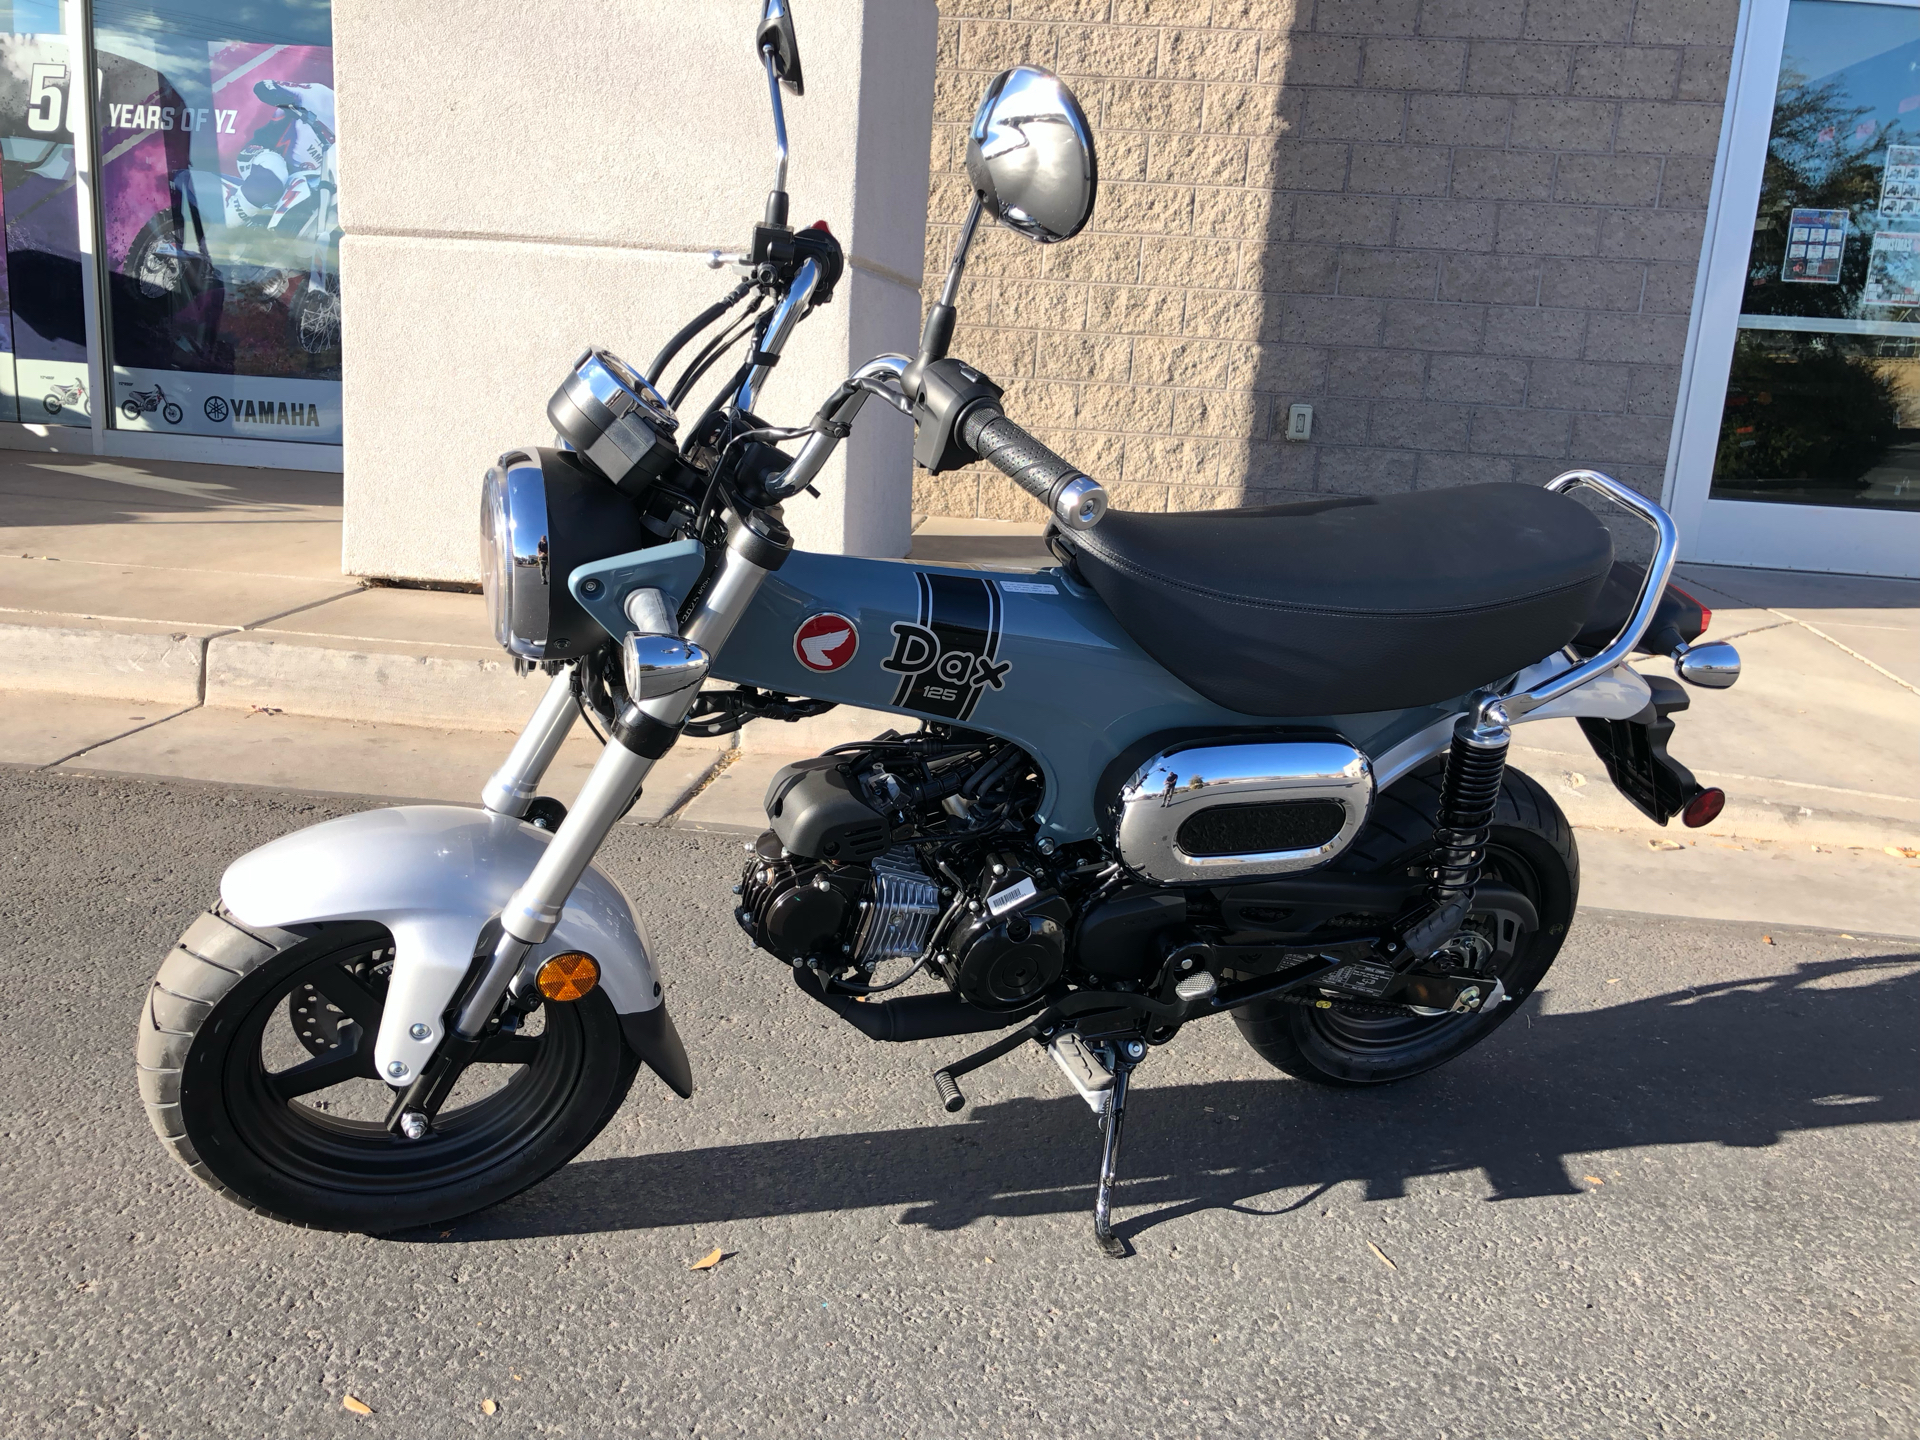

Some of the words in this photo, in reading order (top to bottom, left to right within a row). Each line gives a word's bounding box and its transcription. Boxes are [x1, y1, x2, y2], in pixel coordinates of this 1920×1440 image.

[109, 103, 175, 131] YEARS
[180, 107, 209, 132] OF
[214, 108, 238, 134] YZ
[230, 398, 320, 427] YAMAHA
[880, 621, 1012, 691] Dax
[922, 685, 957, 701] 125
